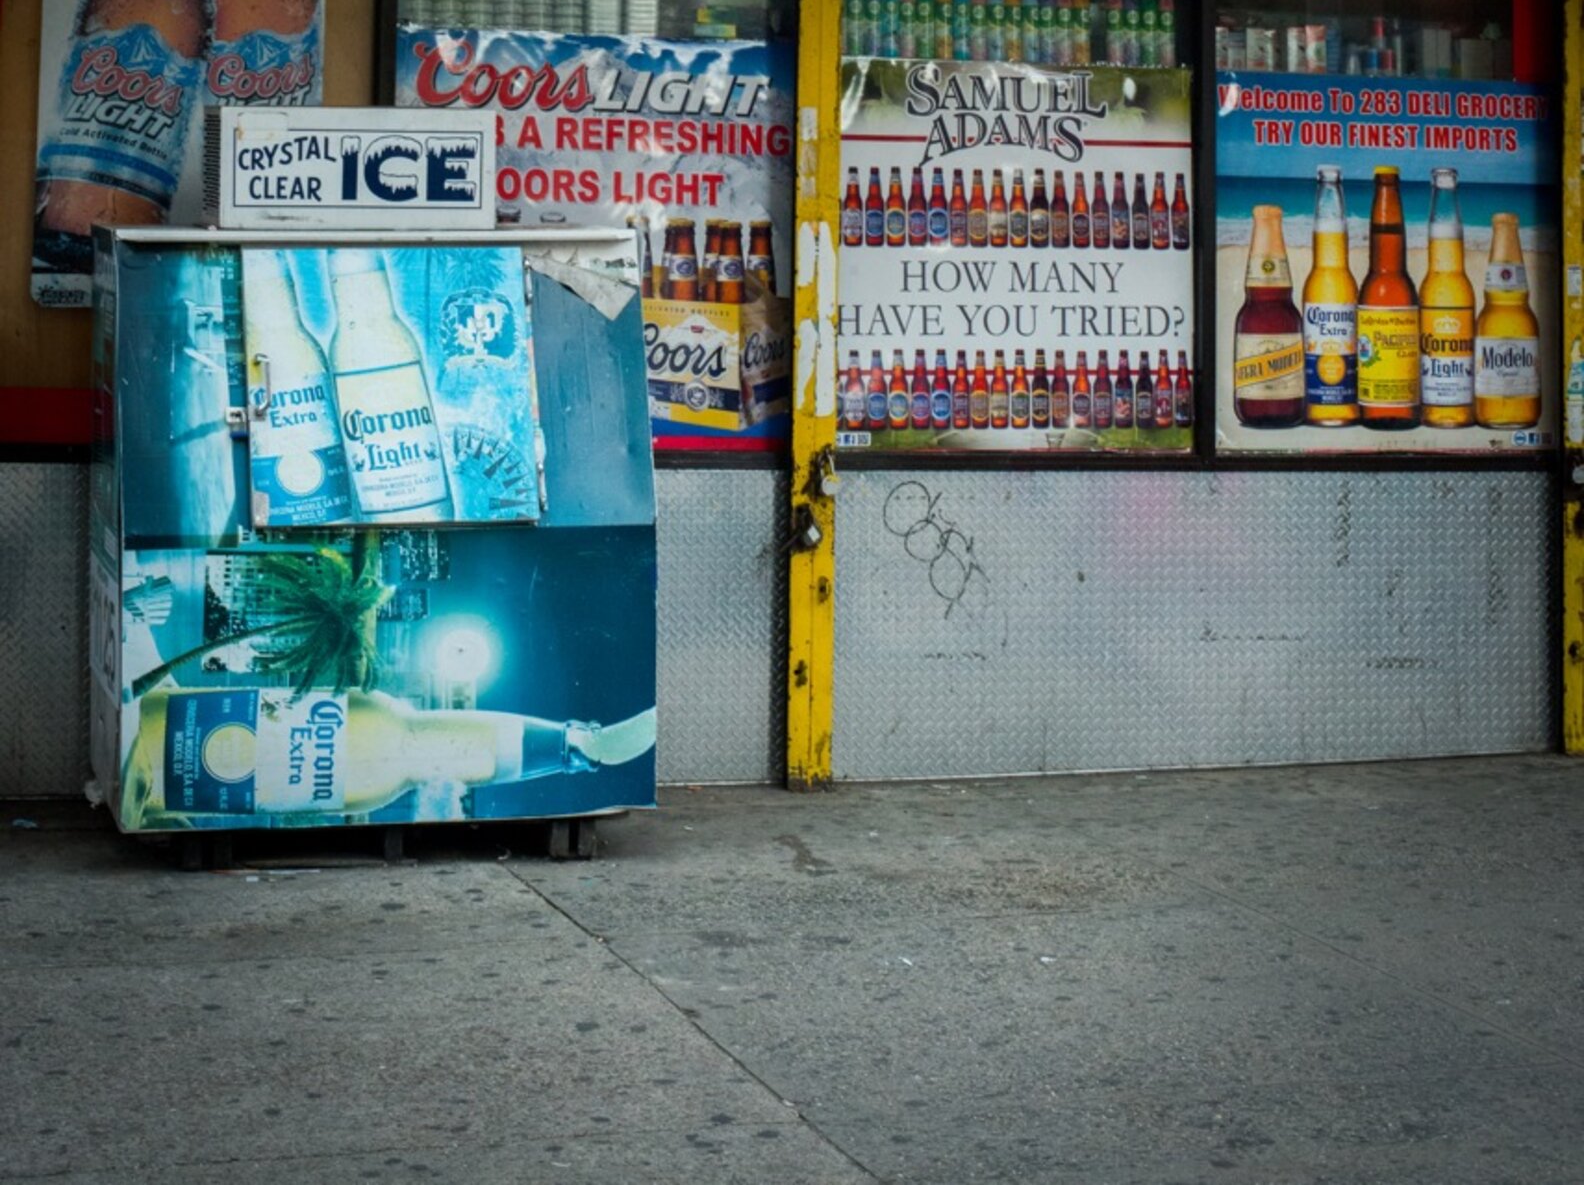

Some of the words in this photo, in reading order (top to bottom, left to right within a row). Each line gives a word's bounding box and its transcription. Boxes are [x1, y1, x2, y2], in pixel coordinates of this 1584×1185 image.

[72, 47, 183, 115] Coors
[206, 53, 315, 99] Coors
[414, 39, 596, 112] Coors
[593, 70, 773, 117] LIGHT
[907, 64, 1107, 118] SAMUEL
[64, 95, 173, 140] LIGHT
[1329, 89, 1354, 114] To
[1359, 90, 1400, 115] 283
[1407, 92, 1450, 117] DELI
[238, 136, 337, 170] CRYSTAL
[518, 116, 543, 149] A
[556, 116, 790, 156] REFRESHING
[919, 112, 1085, 166] ADAMS
[1254, 121, 1294, 145] TRY
[1300, 122, 1343, 146] OUR
[1348, 123, 1418, 148] FINEST
[1425, 126, 1517, 151] IMPORTS
[340, 135, 478, 202] ICE
[496, 168, 600, 202] OORS
[612, 172, 724, 207] LIGHT
[250, 175, 321, 201] CLEAR
[900, 261, 997, 293] HOW
[1008, 261, 1124, 293] MANY
[837, 305, 945, 337] HAVE
[956, 305, 1039, 337] YOU
[1050, 305, 1185, 337] TRIED?
[1319, 324, 1348, 336] Extra
[1431, 359, 1464, 379] Light
[1482, 346, 1533, 370] Modelo
[269, 410, 317, 428] Extra
[343, 406, 432, 444] Corona
[364, 440, 420, 471] Light
[289, 727, 312, 785] Extra
[307, 700, 343, 802] Corona
